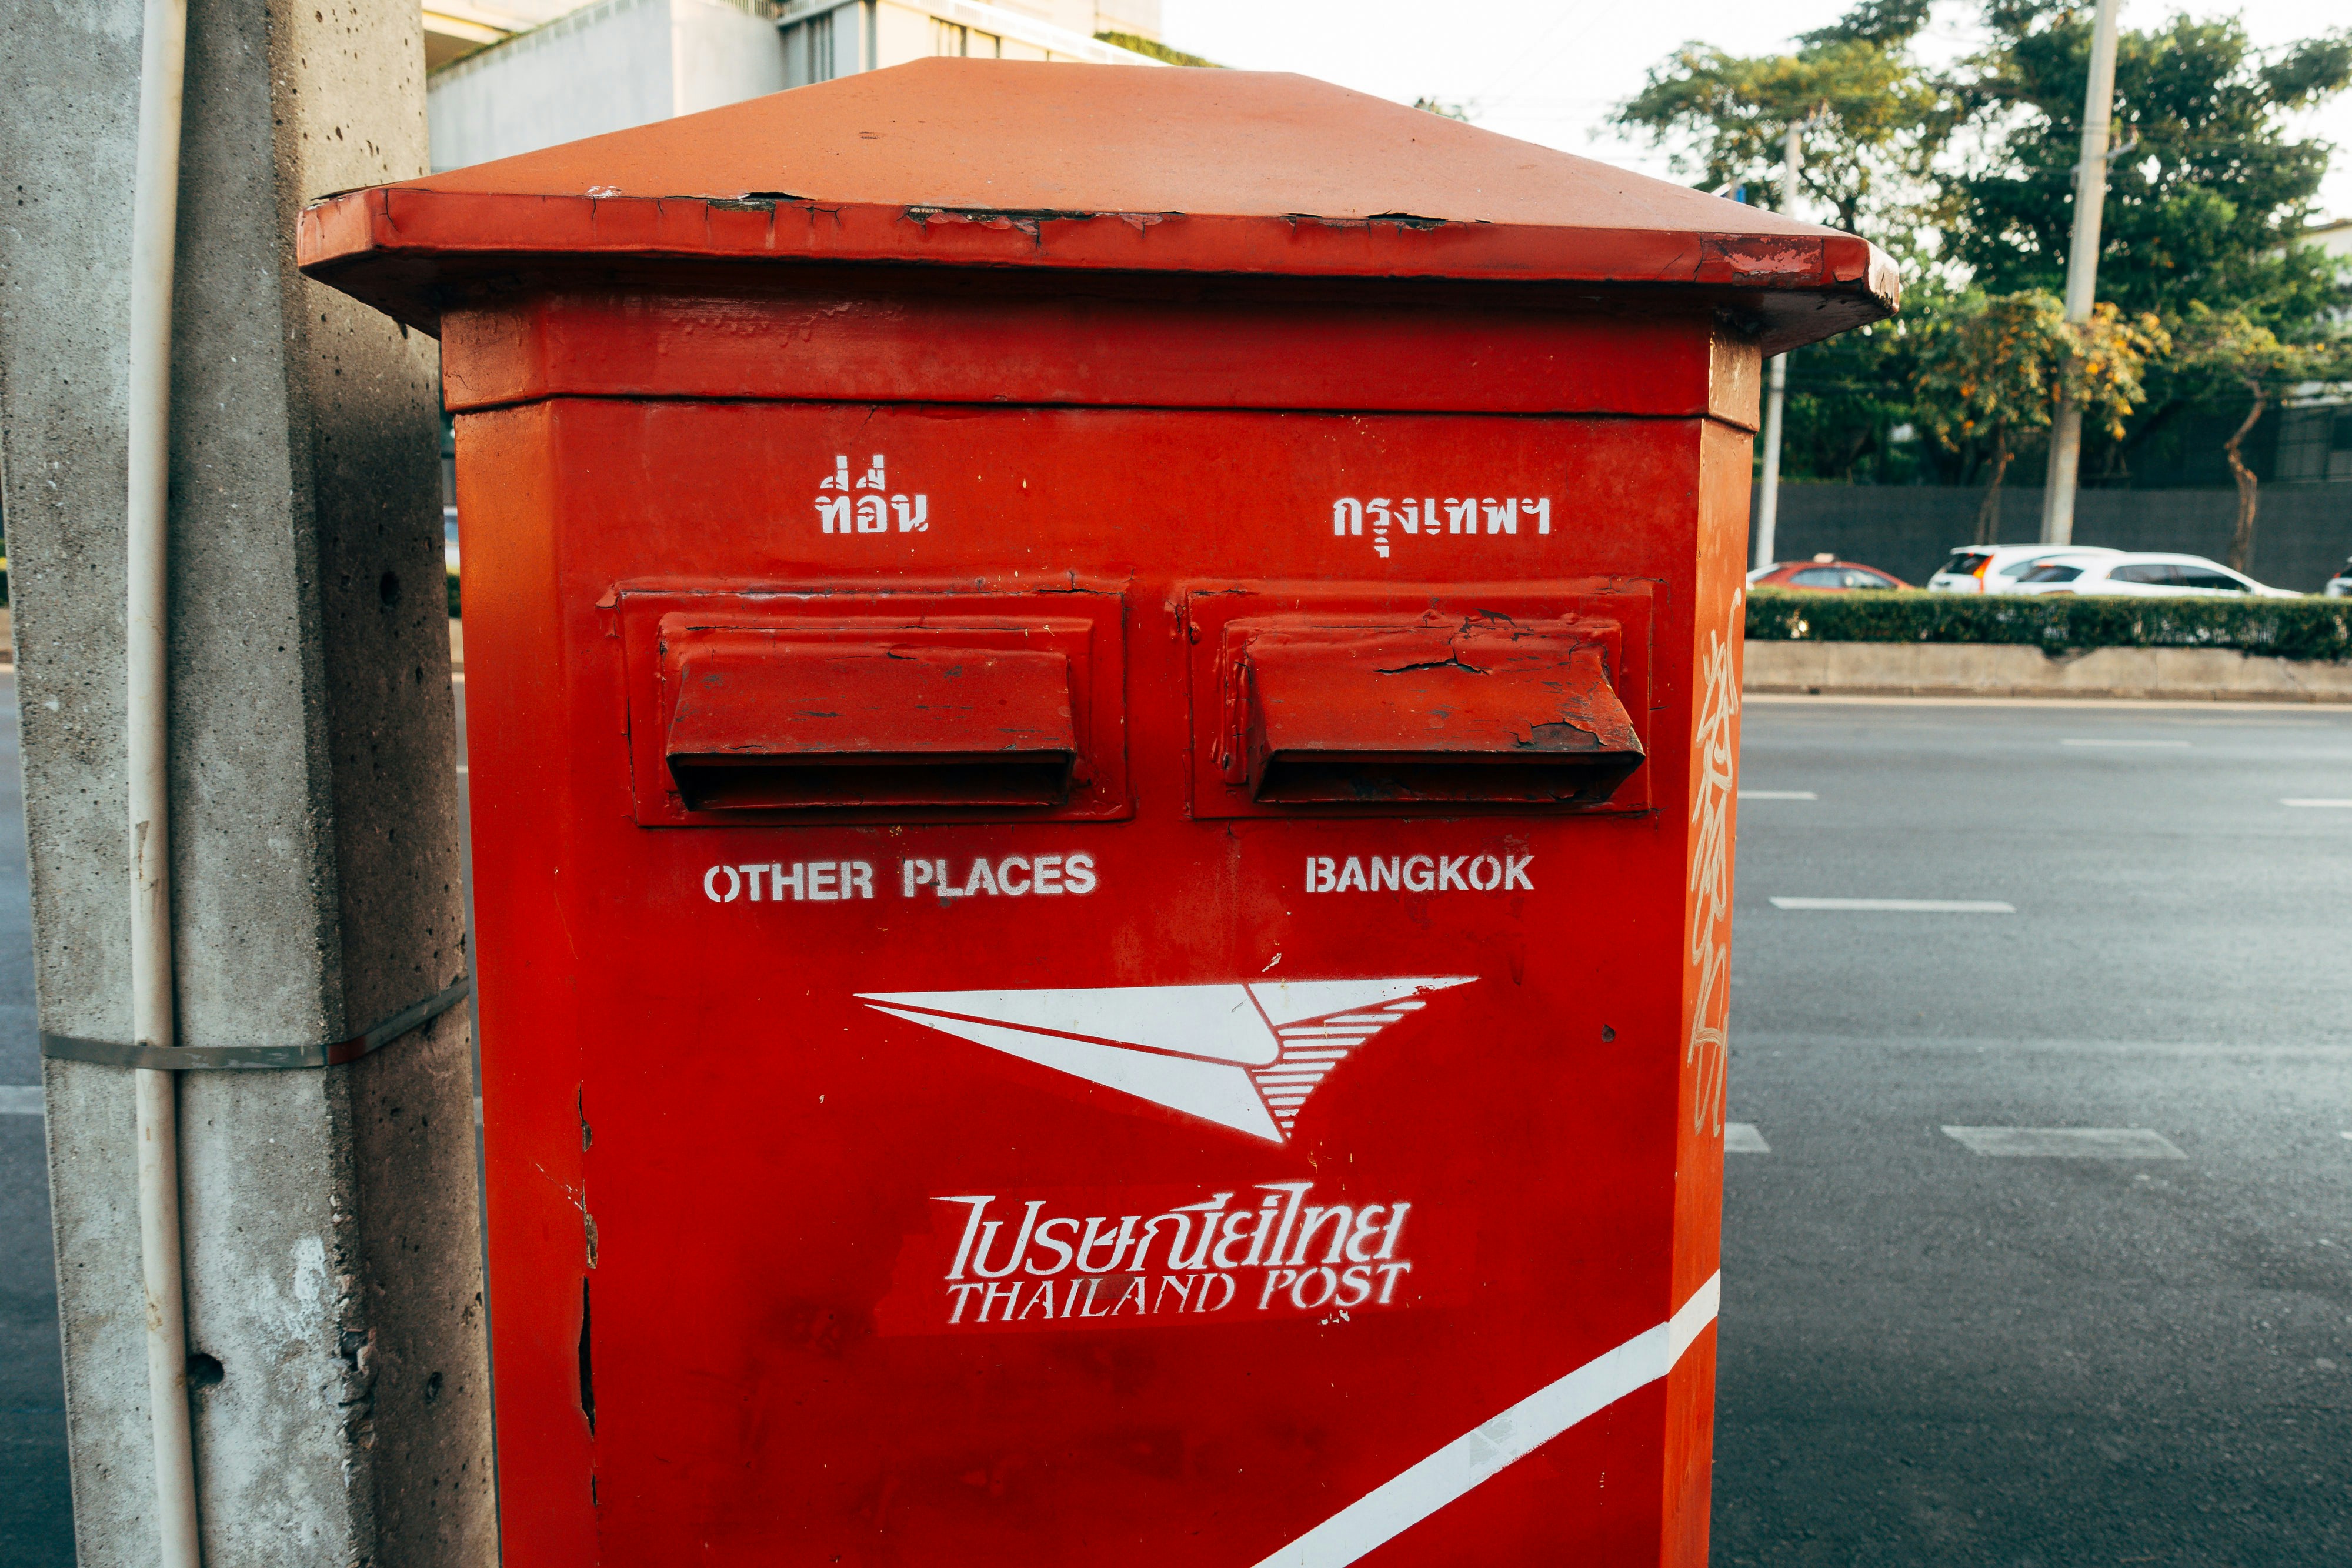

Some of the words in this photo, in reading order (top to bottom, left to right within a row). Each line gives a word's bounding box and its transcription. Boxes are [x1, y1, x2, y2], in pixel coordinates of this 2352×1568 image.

[814, 454, 929, 534] ที่อื่น
[1333, 497, 1550, 558] กรุงเทพฯ
[703, 860, 874, 903] OTHER
[903, 853, 1097, 898] PLACES
[1306, 855, 1534, 893] BANGKOK
[930, 1182, 1412, 1280] ไปรษณีย์ไทย
[946, 1273, 1236, 1324] THAILAND
[1260, 1261, 1412, 1310] POST
